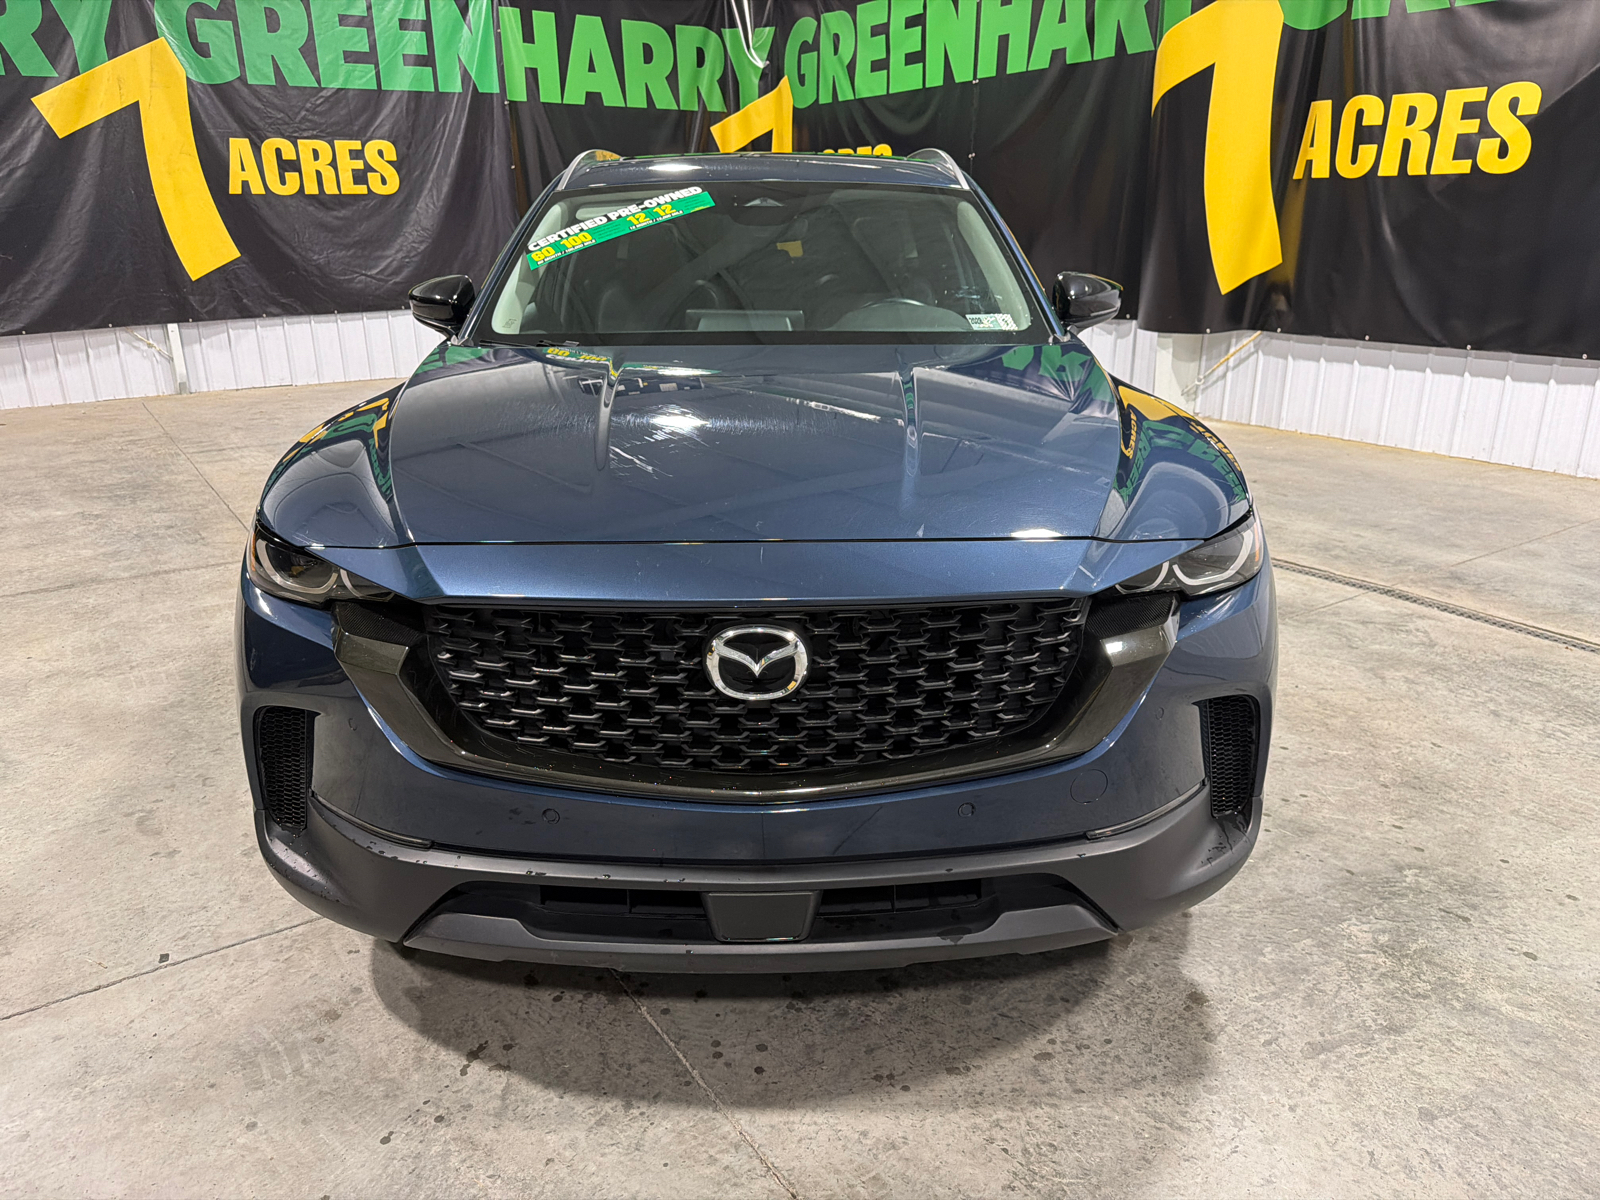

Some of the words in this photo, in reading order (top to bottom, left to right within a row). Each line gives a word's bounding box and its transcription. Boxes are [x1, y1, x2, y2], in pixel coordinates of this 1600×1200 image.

[155, 0, 500, 93] GREEN
[500, 7, 775, 111] HARRY
[784, 0, 976, 109] GREEN
[31, 37, 241, 281] 7
[228, 137, 400, 195] ACRES
[1152, 0, 1284, 295] 7
[1293, 81, 1542, 180] ACRES
[528, 216, 608, 251] CERTIFIED
[606, 186, 703, 221] PRE-OWNED
[531, 246, 556, 262] 60
[560, 231, 593, 249] 100
[626, 213, 650, 225] 12
[653, 204, 677, 216] 12
